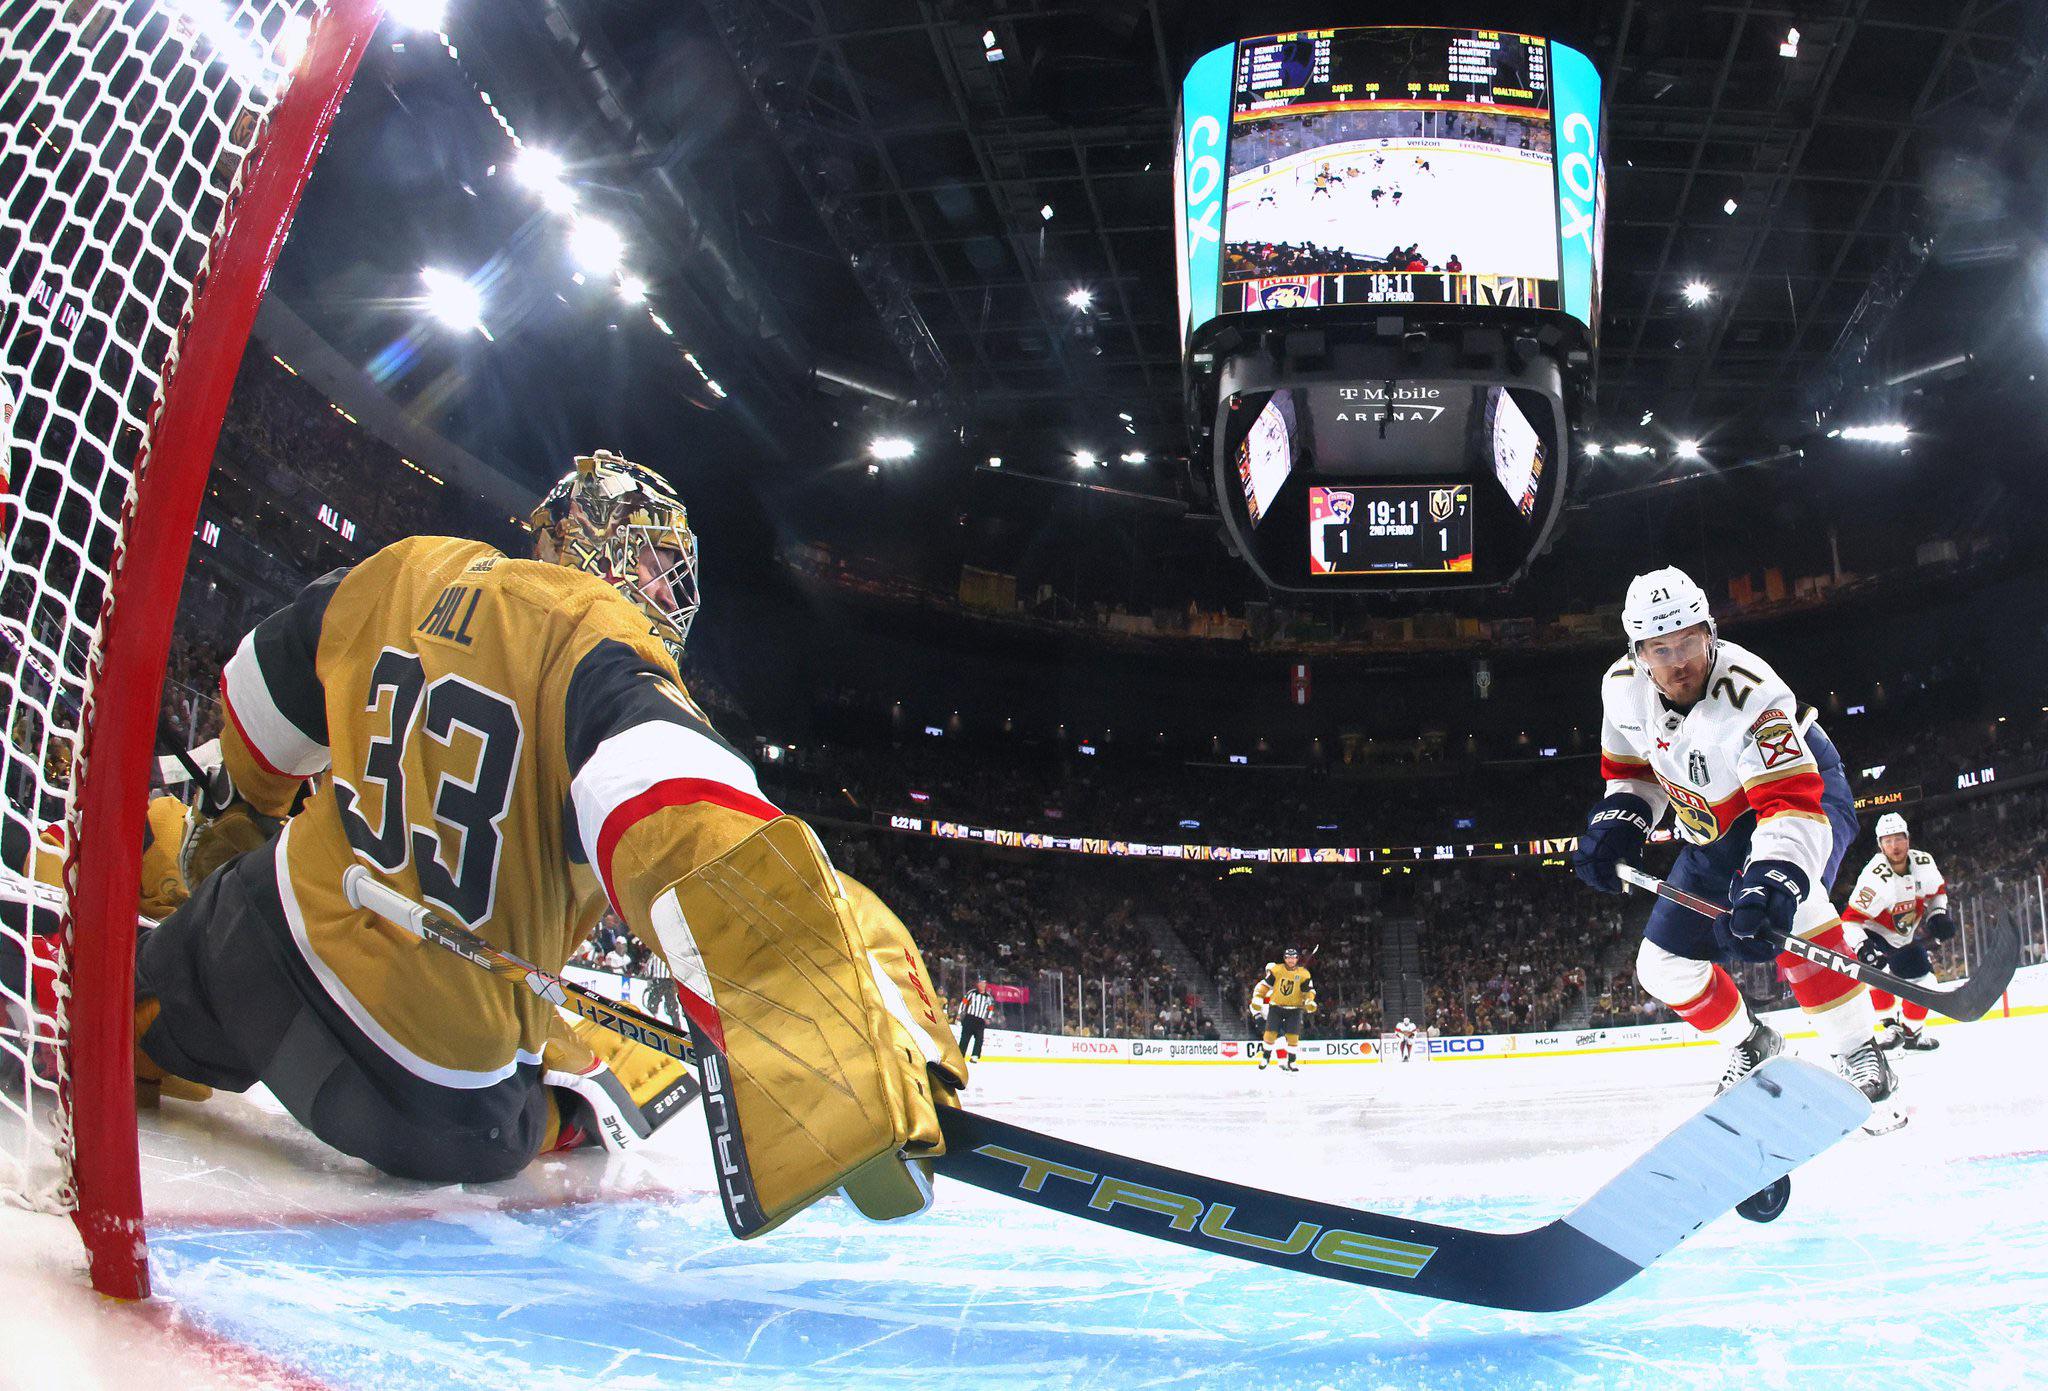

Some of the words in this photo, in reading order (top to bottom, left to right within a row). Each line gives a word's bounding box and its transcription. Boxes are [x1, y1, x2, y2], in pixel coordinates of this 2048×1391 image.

[1332, 84, 1353, 93] SAVES
[1428, 83, 1450, 92] SAVES
[1492, 86, 1533, 99] GOALTENDER
[1459, 142, 1501, 153] HONDA
[1188, 115, 1221, 260] COX
[1562, 113, 1594, 254] COX
[1334, 275, 1344, 303] 1
[1370, 274, 1413, 293] 19:11
[1440, 274, 1450, 302] 1
[1368, 292, 1384, 302] 2ND
[1385, 291, 1415, 302] PERIOD
[1336, 412, 1424, 421] ARENA
[317, 504, 338, 532] ALL
[340, 519, 356, 542] IN
[1368, 500, 1419, 526] 19:11
[201, 520, 220, 548] IN
[1340, 530, 1348, 553] 1
[1369, 525, 1385, 536] 2ND
[1386, 525, 1414, 536] PERIOD
[1439, 528, 1447, 551] 1
[1651, 588, 1671, 603] 21
[417, 586, 482, 647] HILL
[1711, 664, 1765, 711] 21
[332, 645, 525, 931] 33
[1957, 772, 1979, 789] ALL
[1981, 767, 1995, 782] IN
[1875, 793, 1902, 805] REALM
[910, 818, 922, 831] PM
[1872, 863, 1893, 883] 62
[422, 927, 491, 969] TRUE
[1784, 937, 1861, 979] CCM
[1072, 1042, 1118, 1053] HONDA
[1170, 1043, 1218, 1058] guaranteed
[1415, 1039, 1484, 1053] GEICO
[602, 1115, 631, 1149] TRUE
[702, 1054, 746, 1228] TRUE
[972, 1144, 1439, 1278] TRUE
